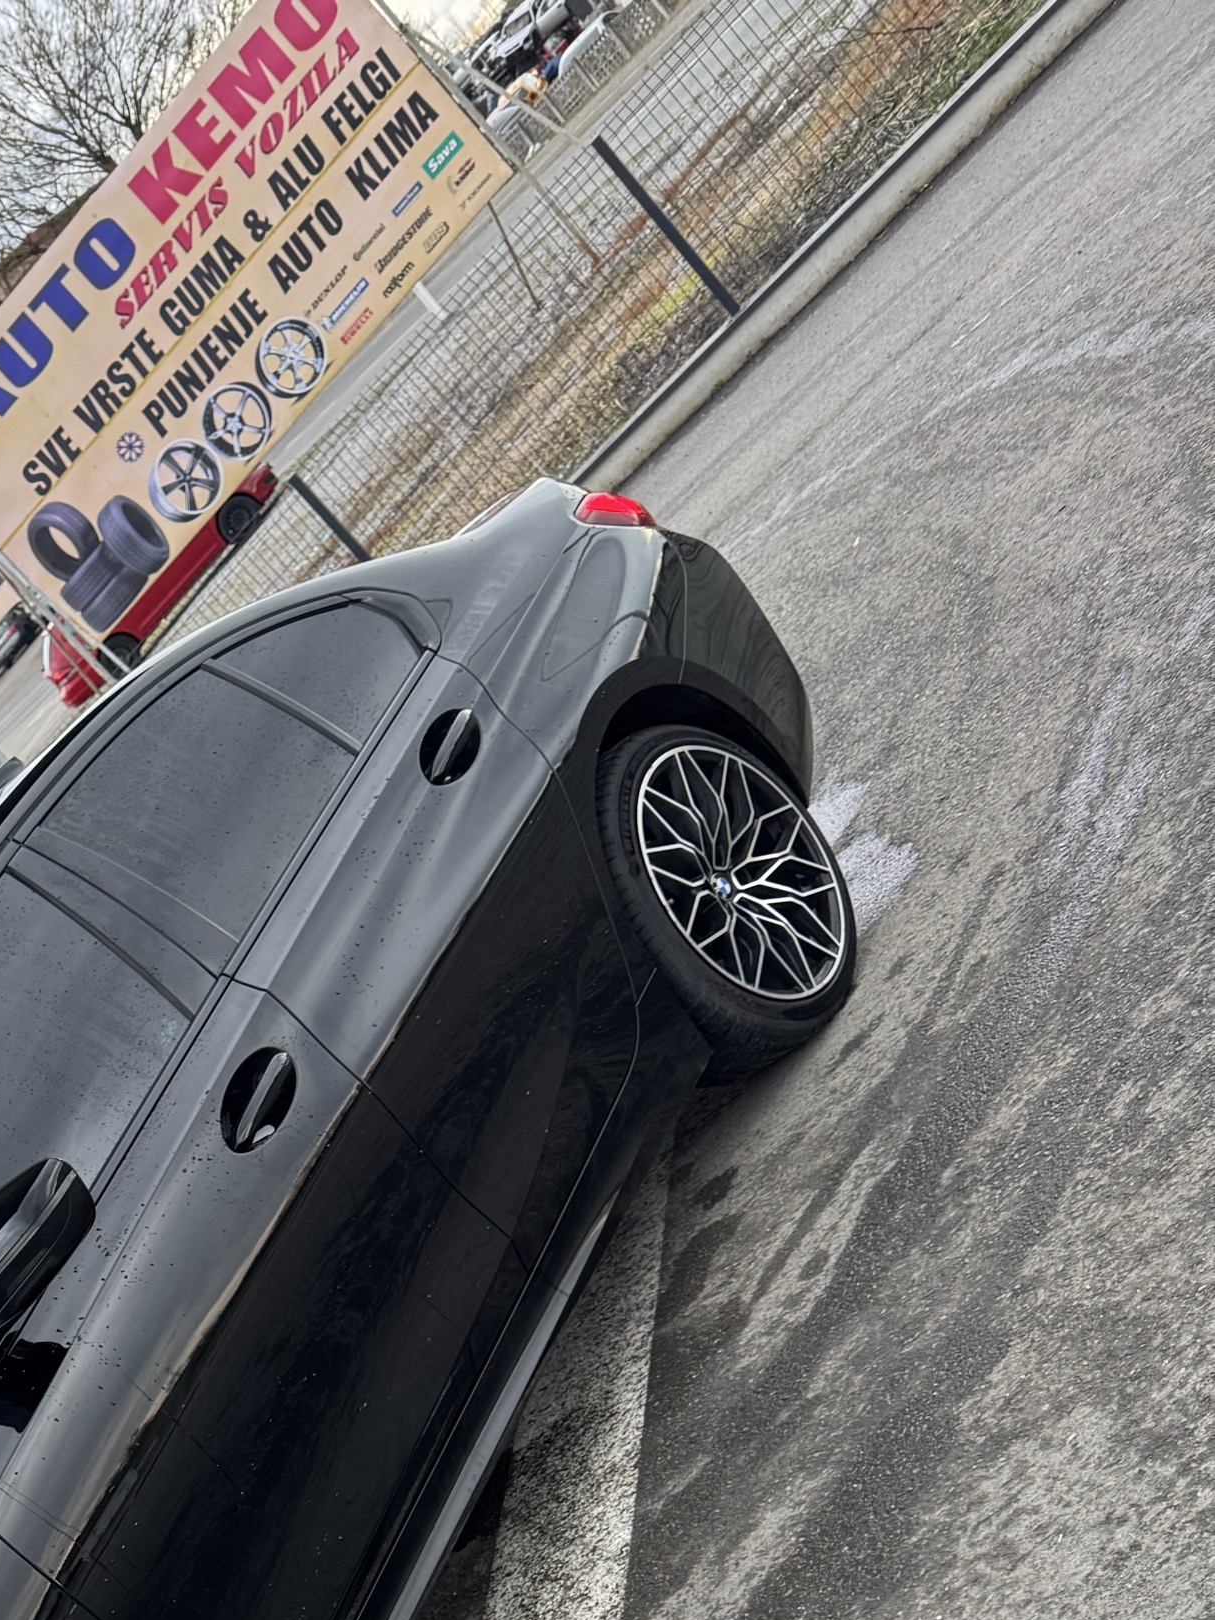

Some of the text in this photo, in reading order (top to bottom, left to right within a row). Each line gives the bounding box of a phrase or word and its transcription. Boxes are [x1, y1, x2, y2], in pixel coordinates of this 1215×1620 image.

[114, 27, 360, 329] SERVIS VOZILA
[127, 0, 338, 226] KEMO
[427, 136, 458, 174] Sava
[22, 46, 402, 496] SVE VRSTE GUMA & ALU FELGI
[141, 91, 441, 439] PUNJENJE AUTO KLIMA
[311, 264, 349, 311] DUNLOP
